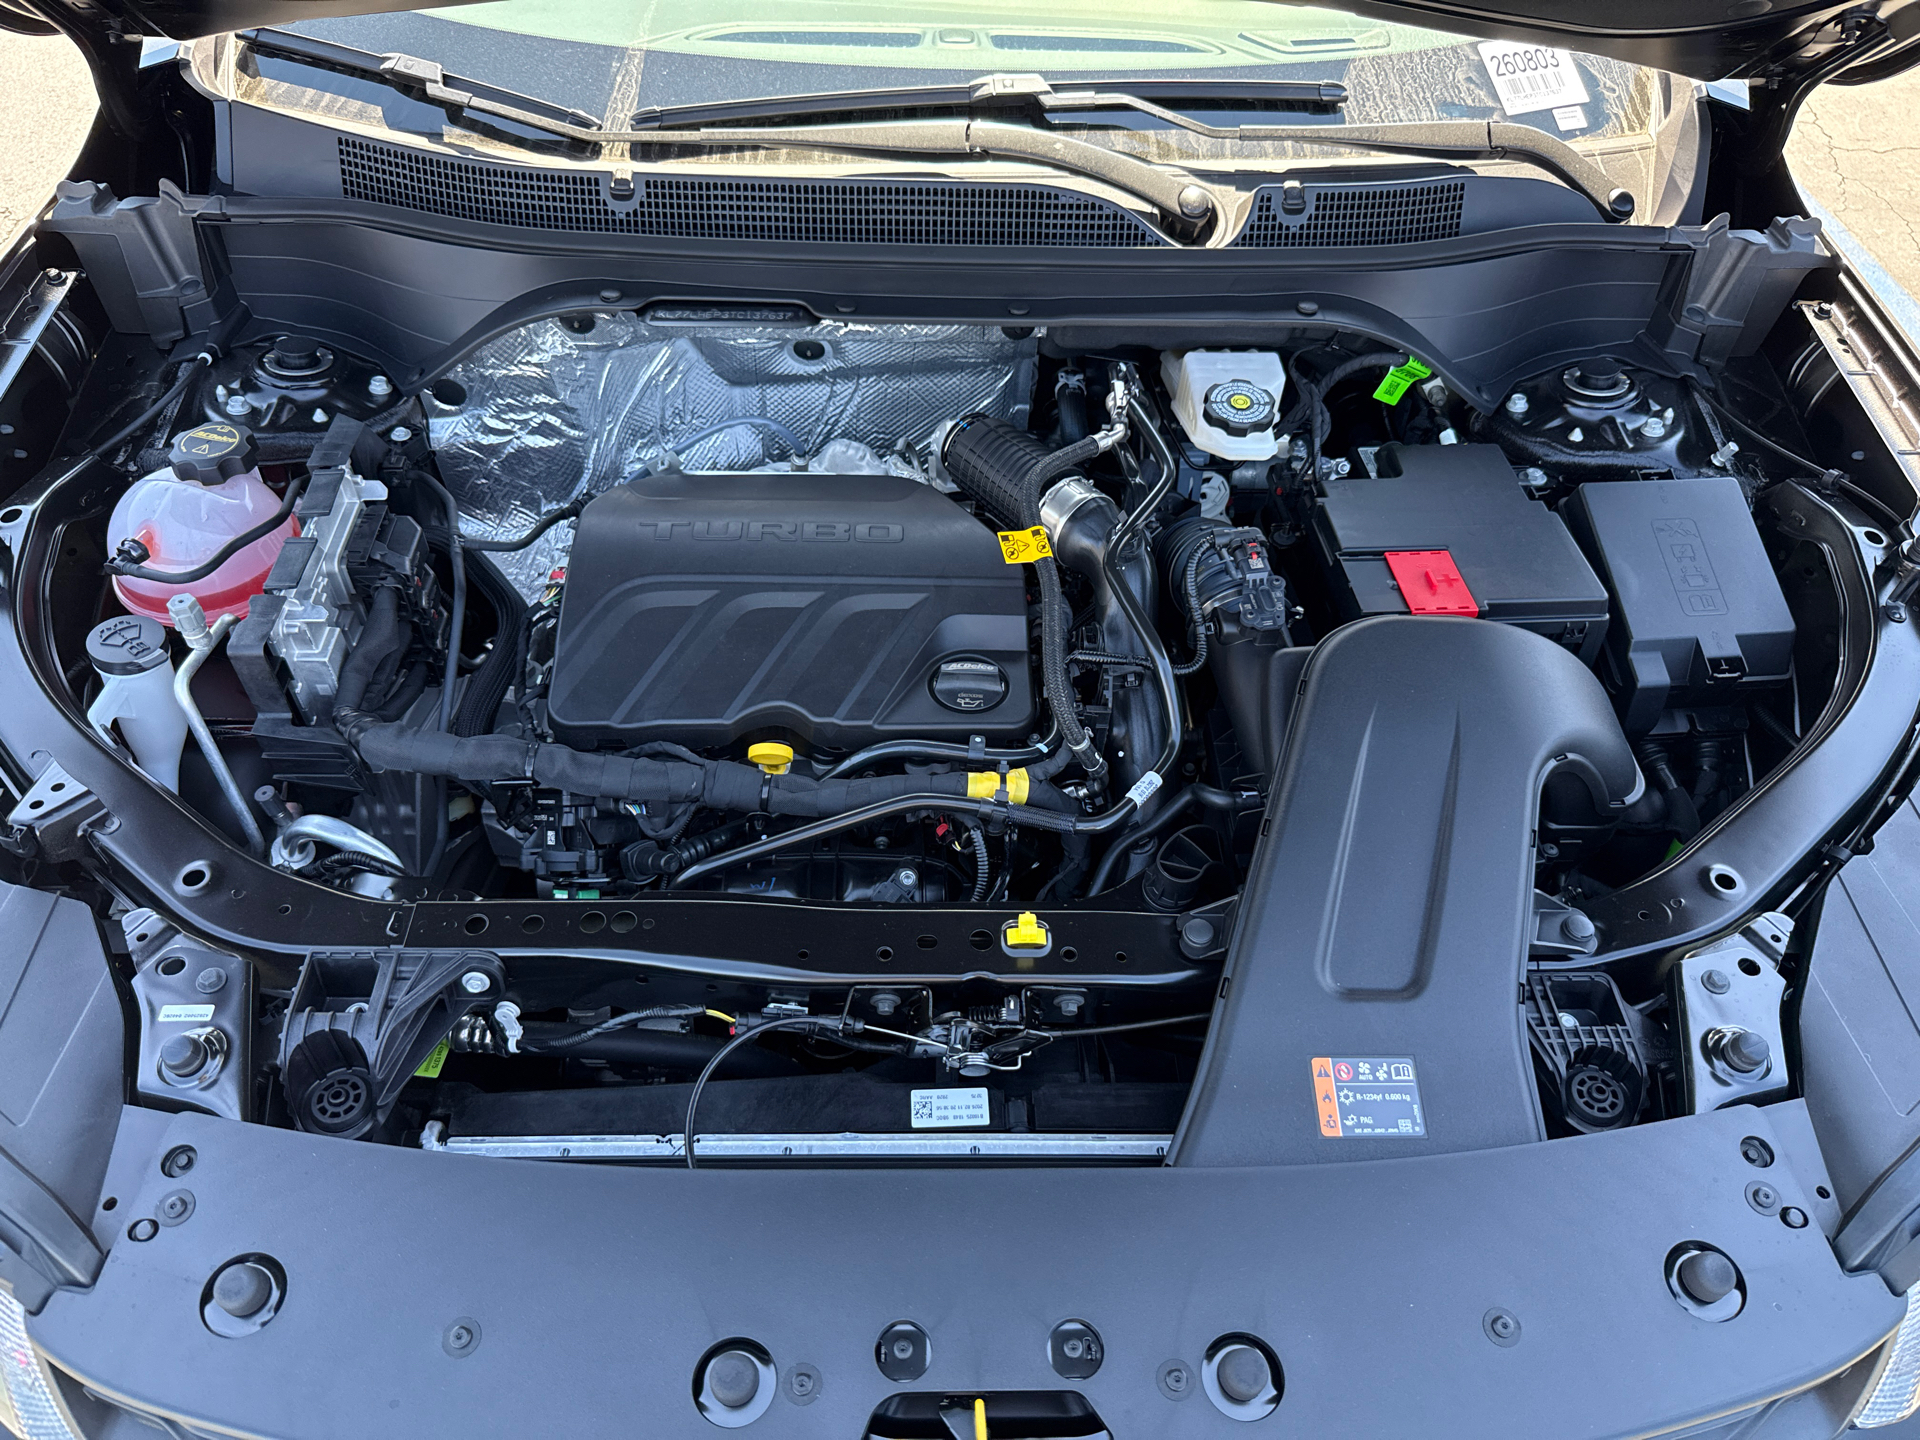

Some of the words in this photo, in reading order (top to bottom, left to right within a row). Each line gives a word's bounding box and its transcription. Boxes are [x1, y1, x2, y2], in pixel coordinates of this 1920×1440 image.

[1490, 48, 1560, 77] 260803
[639, 521, 905, 543] TURBO
[948, 662, 995, 671] ACDelco
[1402, 1093, 1411, 1102] kg
[1360, 1116, 1374, 1124] PAG
